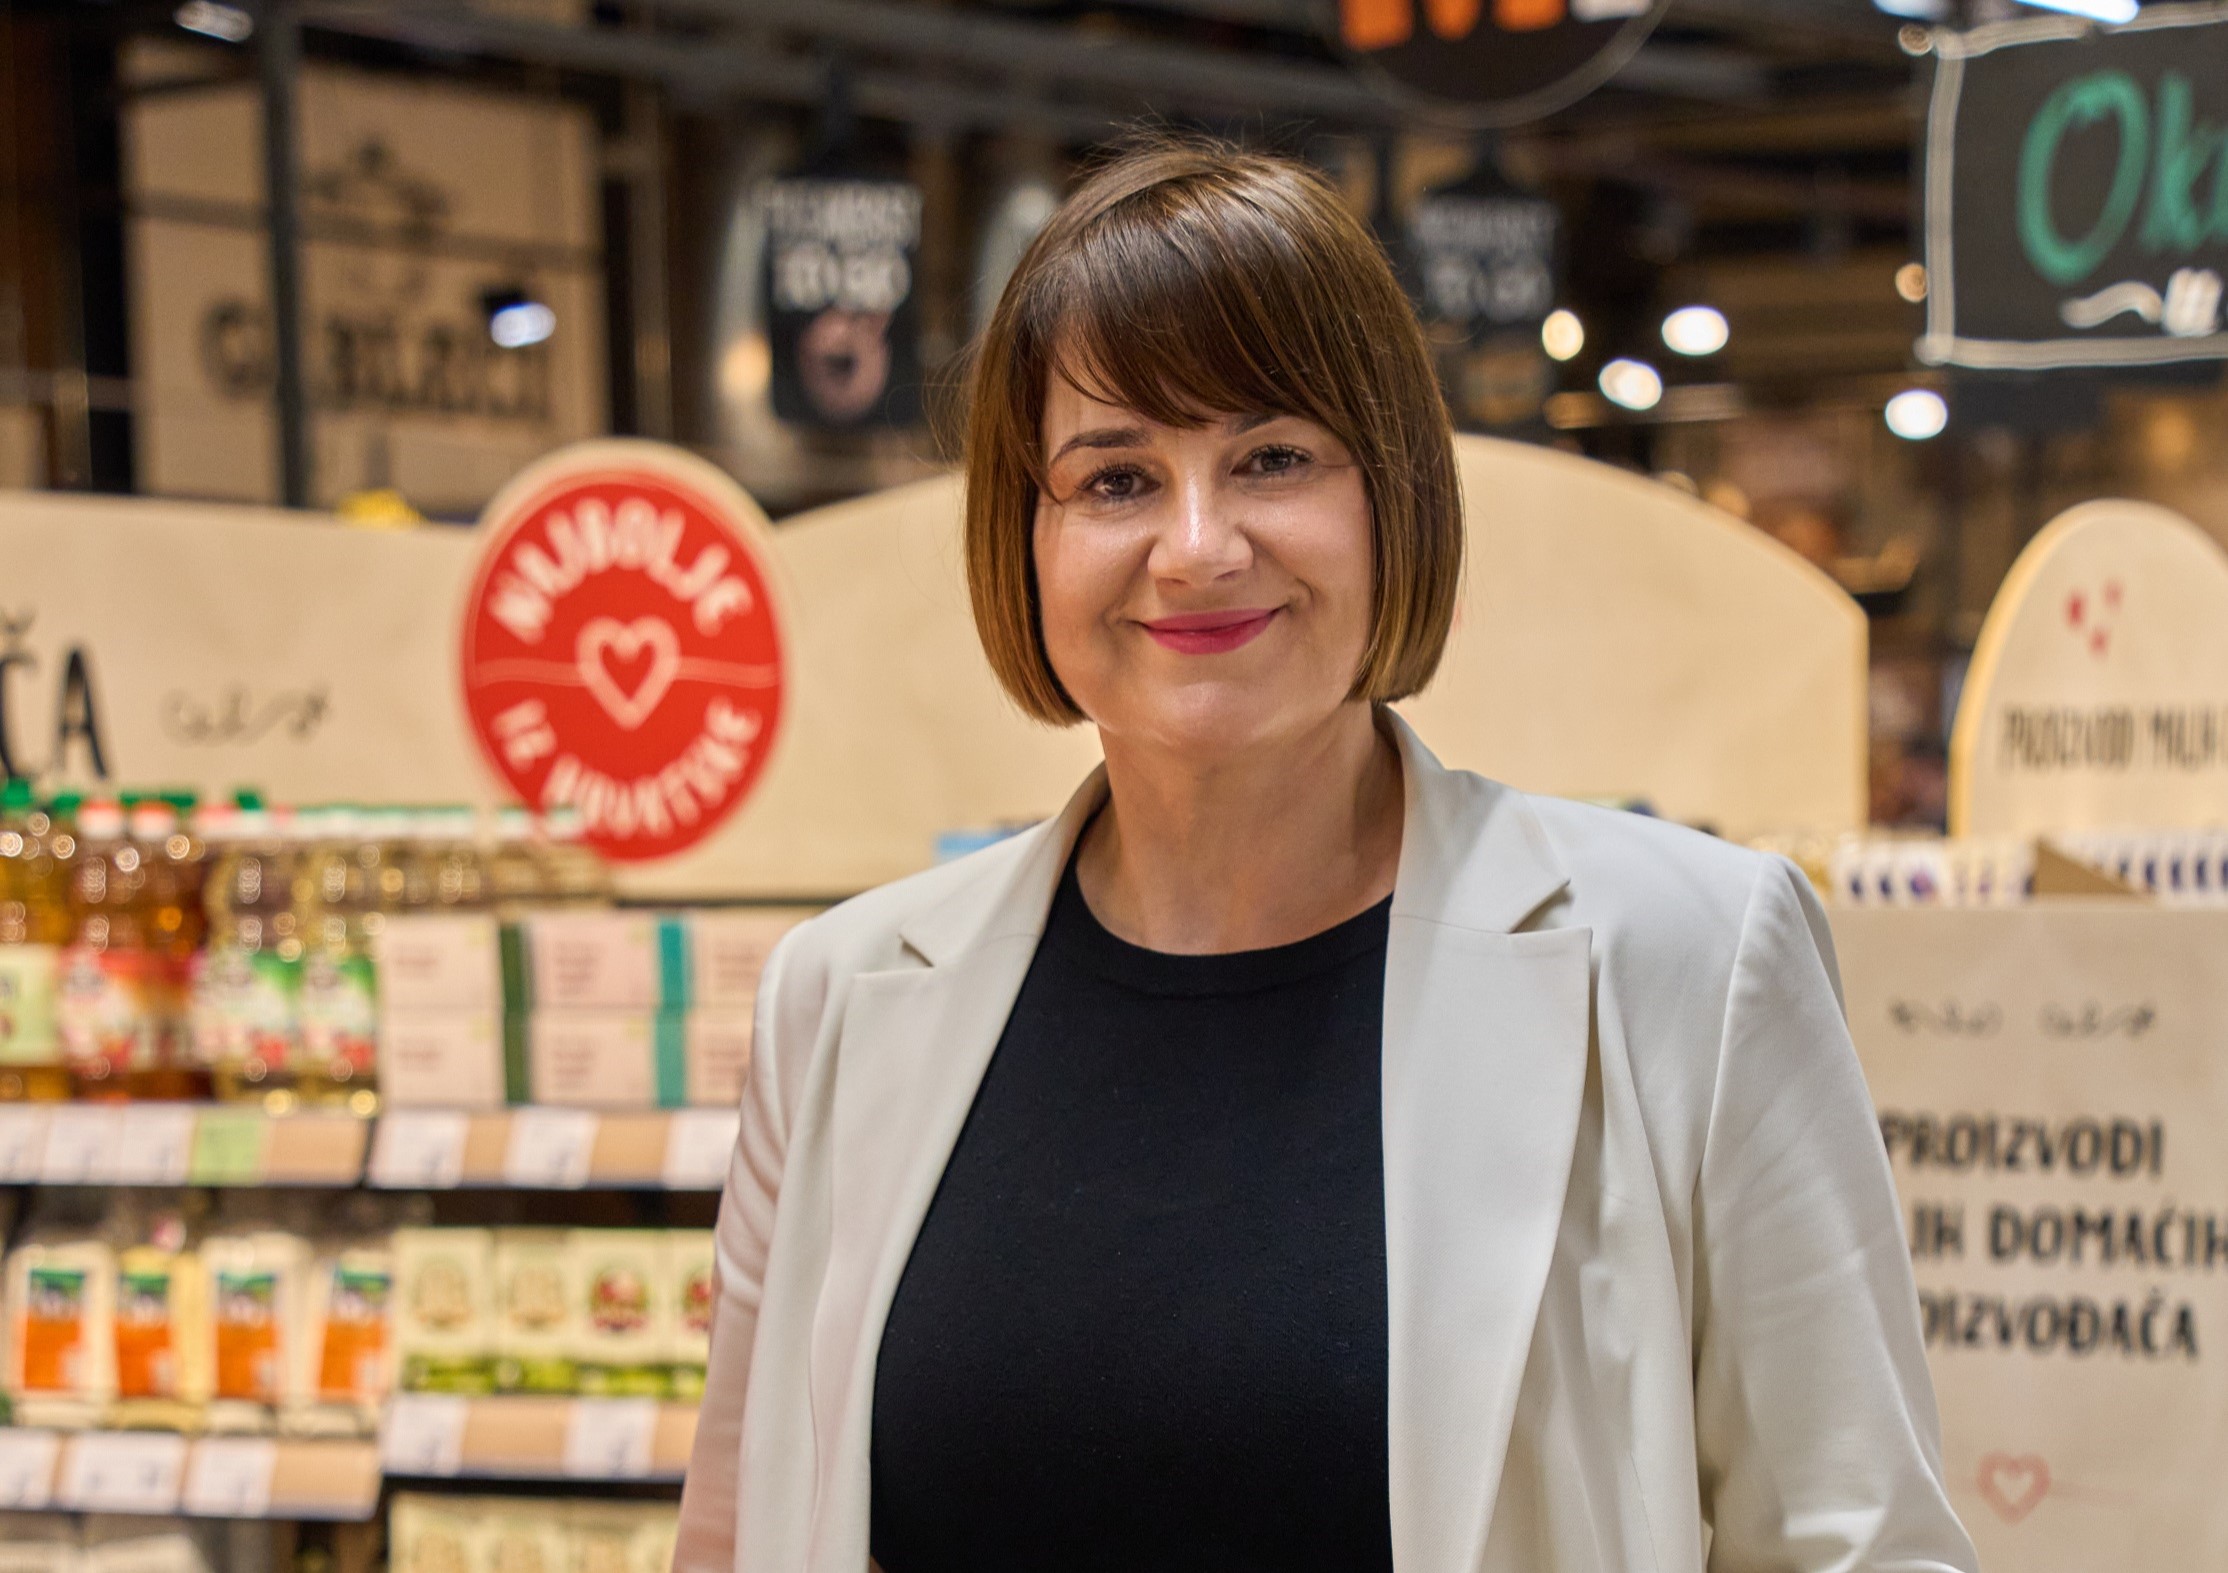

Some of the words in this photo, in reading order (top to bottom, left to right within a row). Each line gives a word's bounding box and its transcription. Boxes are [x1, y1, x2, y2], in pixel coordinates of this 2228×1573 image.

[489, 496, 752, 645] NAJBOLJE
[491, 698, 557, 771] IZ
[1879, 1110, 2165, 1177] PROIZVODI
